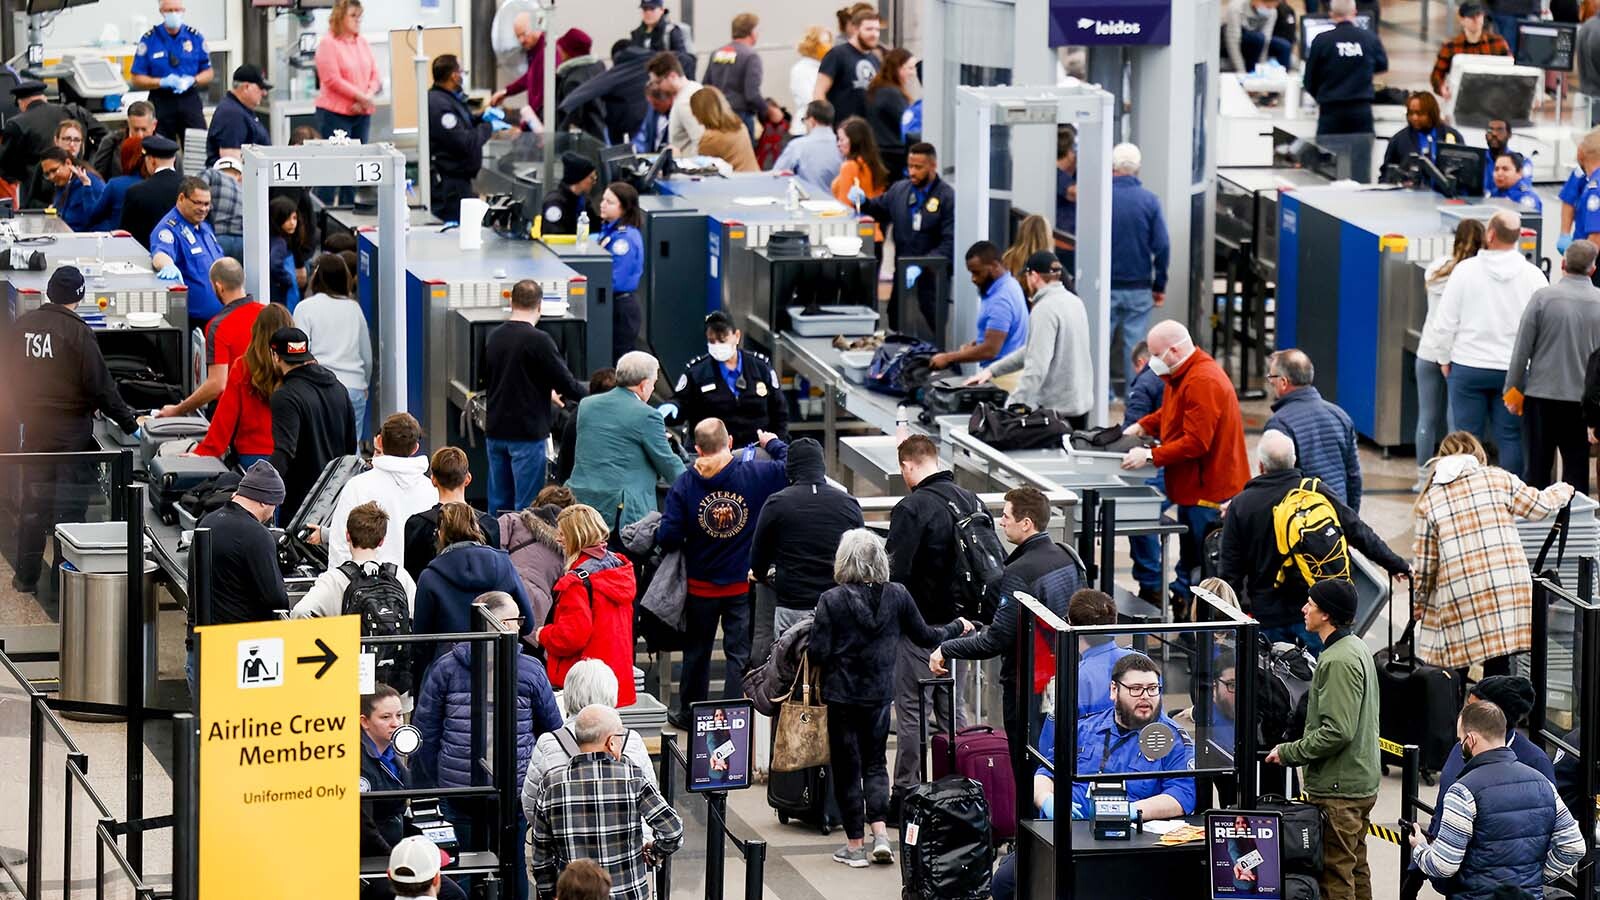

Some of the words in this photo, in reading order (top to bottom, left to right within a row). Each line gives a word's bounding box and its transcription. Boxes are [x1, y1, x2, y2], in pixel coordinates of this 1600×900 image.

[1095, 20, 1141, 35] leidos
[1335, 41, 1364, 57] TSA
[273, 161, 300, 181] 14
[356, 162, 382, 182] 13
[24, 332, 54, 358] TSA
[700, 491, 744, 507] VETERAN
[208, 717, 282, 741] Airline
[290, 714, 346, 735] Crew
[697, 720, 731, 731] REAL
[732, 718, 745, 729] ID
[239, 740, 346, 766] Members
[243, 786, 312, 804] Uniformed
[316, 784, 346, 800] Only
[1215, 827, 1257, 839] REAL
[1258, 827, 1273, 839] ID
